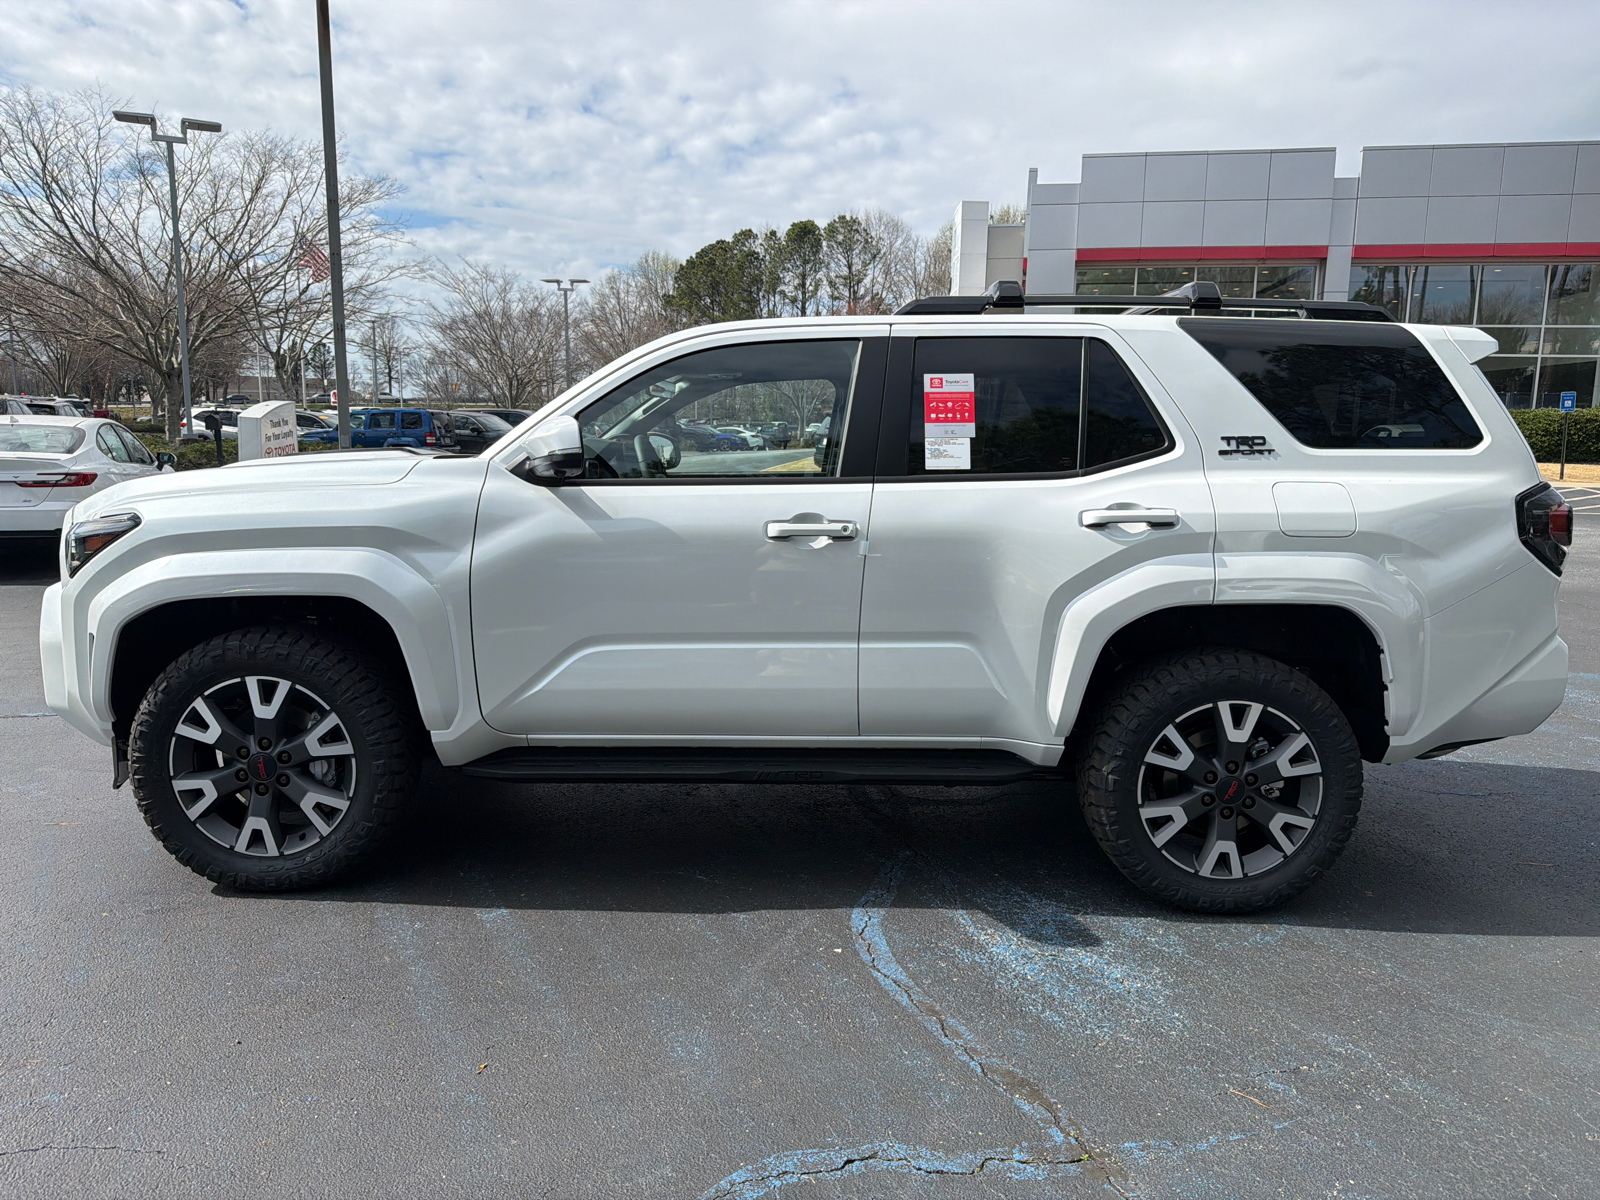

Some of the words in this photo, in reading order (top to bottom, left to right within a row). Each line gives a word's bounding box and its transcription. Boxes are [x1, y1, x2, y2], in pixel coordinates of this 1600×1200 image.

[270, 418, 282, 428] Thank
[281, 418, 289, 426] You
[264, 433, 272, 443] For
[272, 431, 281, 441] Your
[281, 429, 294, 441] Loyalty
[1220, 436, 1266, 449] TRD
[274, 443, 296, 457] TOYOTA
[257, 756, 267, 779] TRD
[778, 770, 823, 780] TRD
[1224, 781, 1238, 800] TRD
